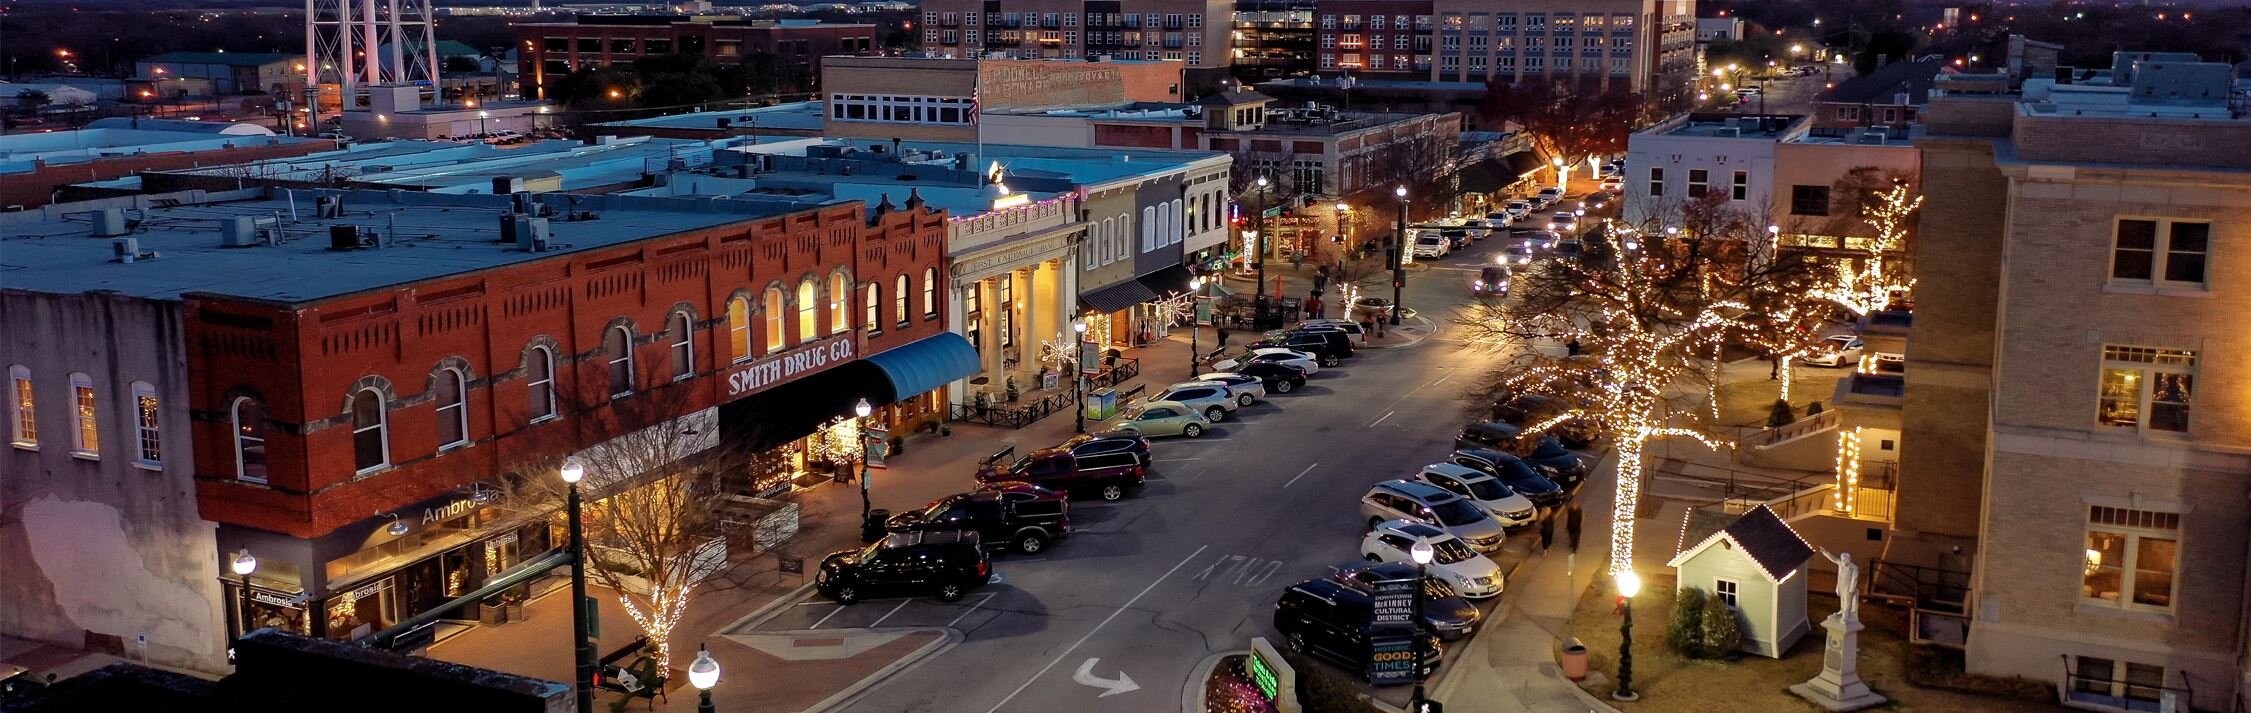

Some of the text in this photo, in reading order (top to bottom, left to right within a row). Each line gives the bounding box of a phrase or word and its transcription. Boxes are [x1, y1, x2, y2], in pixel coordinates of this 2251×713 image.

[728, 338, 853, 396] SMITH DRUG CO.
[256, 592, 293, 607] Ambrosia
[341, 583, 383, 604] Abrosia
[1375, 600, 1412, 608] McKINNEY
[1373, 652, 1411, 661] GOOD
[1374, 661, 1411, 670] TIMES
